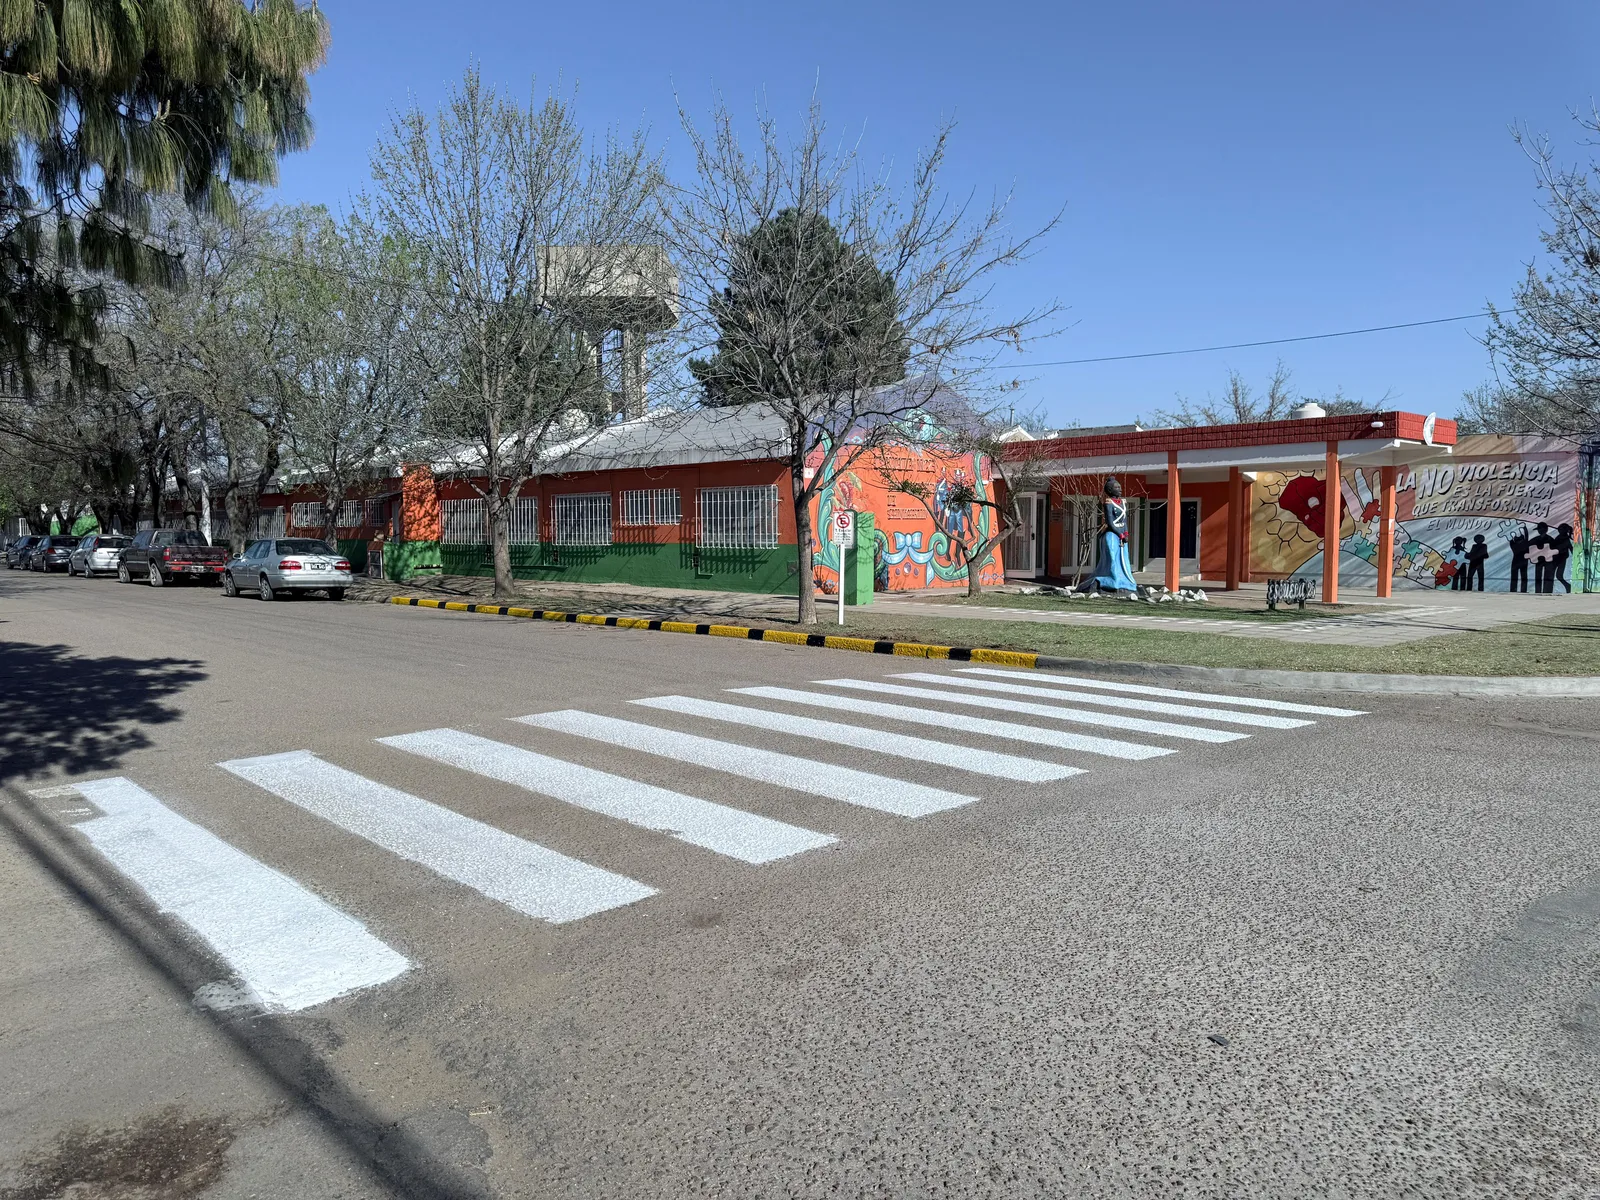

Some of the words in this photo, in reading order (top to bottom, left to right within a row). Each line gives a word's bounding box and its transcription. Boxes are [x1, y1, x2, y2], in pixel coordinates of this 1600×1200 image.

[1396, 472, 1416, 493] LA
[1419, 465, 1456, 499] NO
[1457, 463, 1559, 484] VIOLENCIA
[1453, 485, 1472, 498] ES
[1476, 484, 1492, 497] LA
[1497, 484, 1556, 499] FUERZA
[1412, 501, 1439, 517] QUE
[1427, 519, 1440, 531] EL
[1445, 519, 1493, 531] MUNDO
